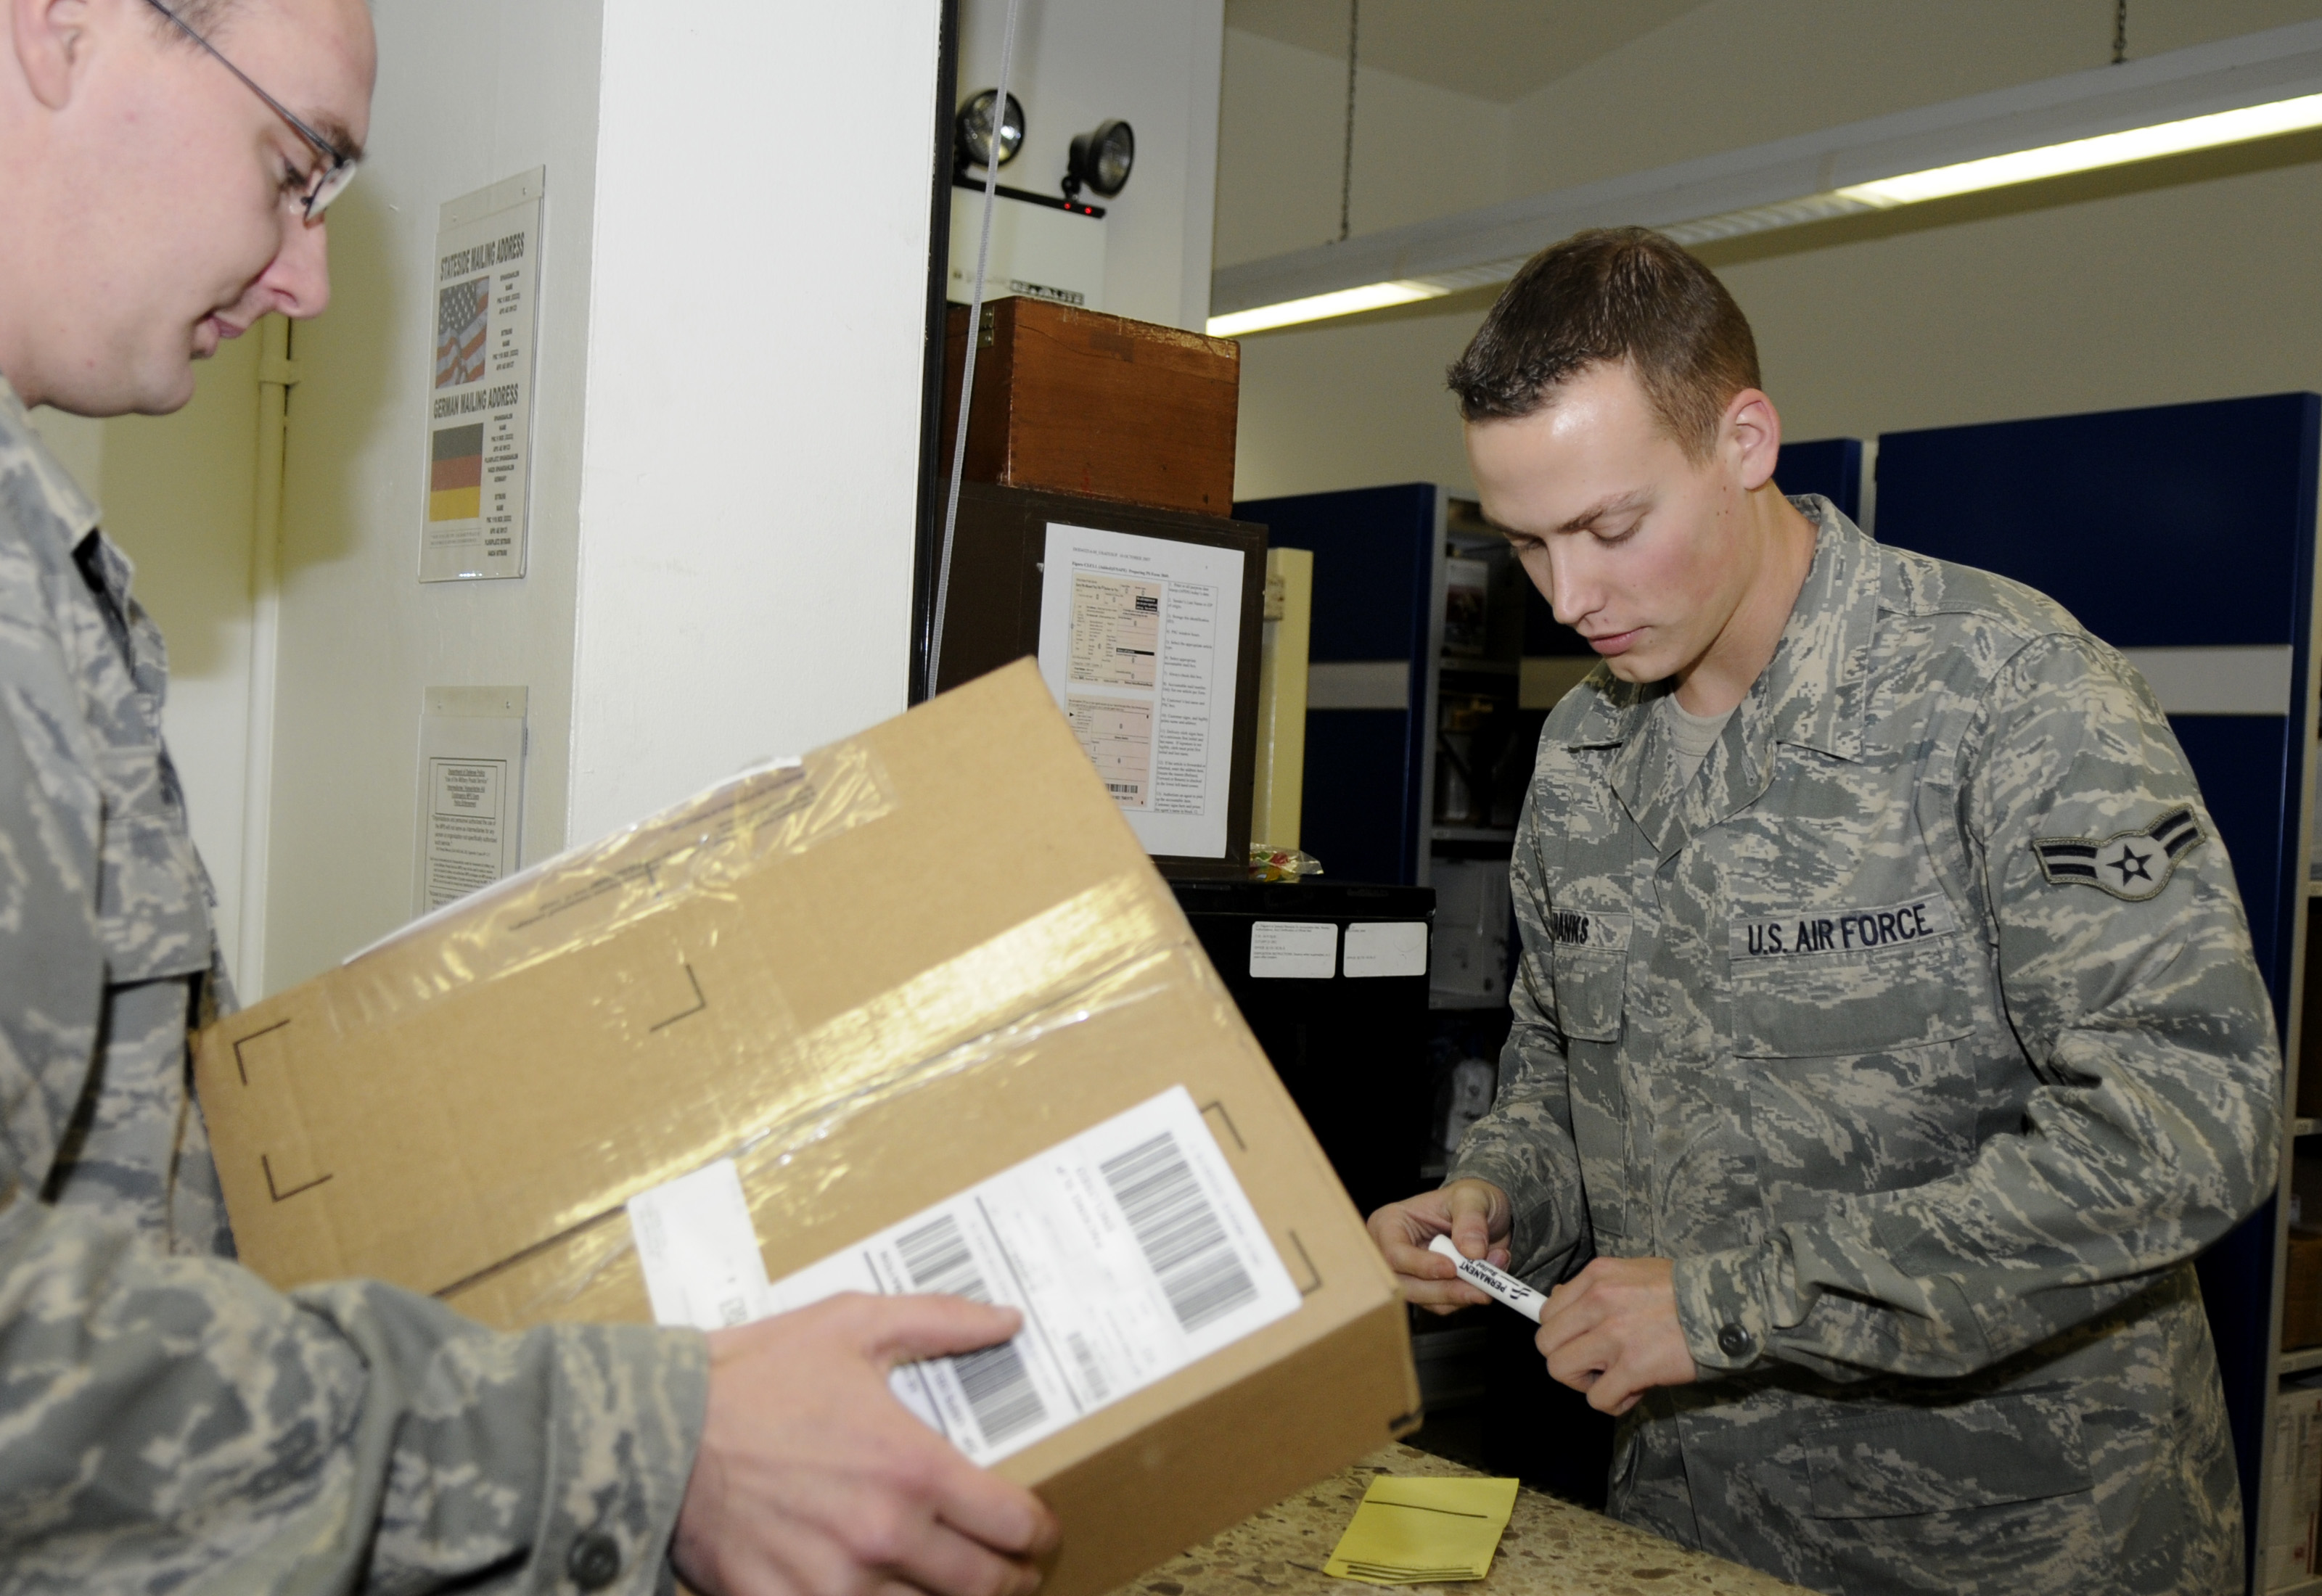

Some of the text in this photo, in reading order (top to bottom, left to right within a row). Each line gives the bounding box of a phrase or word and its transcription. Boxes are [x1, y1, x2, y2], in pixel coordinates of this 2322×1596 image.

[440, 231, 525, 281] STATESIDE MAILING ADDRESS
[434, 382, 518, 419] GERMAN MAILING ADDRESS
[1553, 913, 1589, 945] ANKS
[1747, 904, 1934, 956] U.S. AIR FORCE
[1459, 1262, 1508, 1293] PERMANENT
[1475, 1263, 1498, 1278] Bullet
